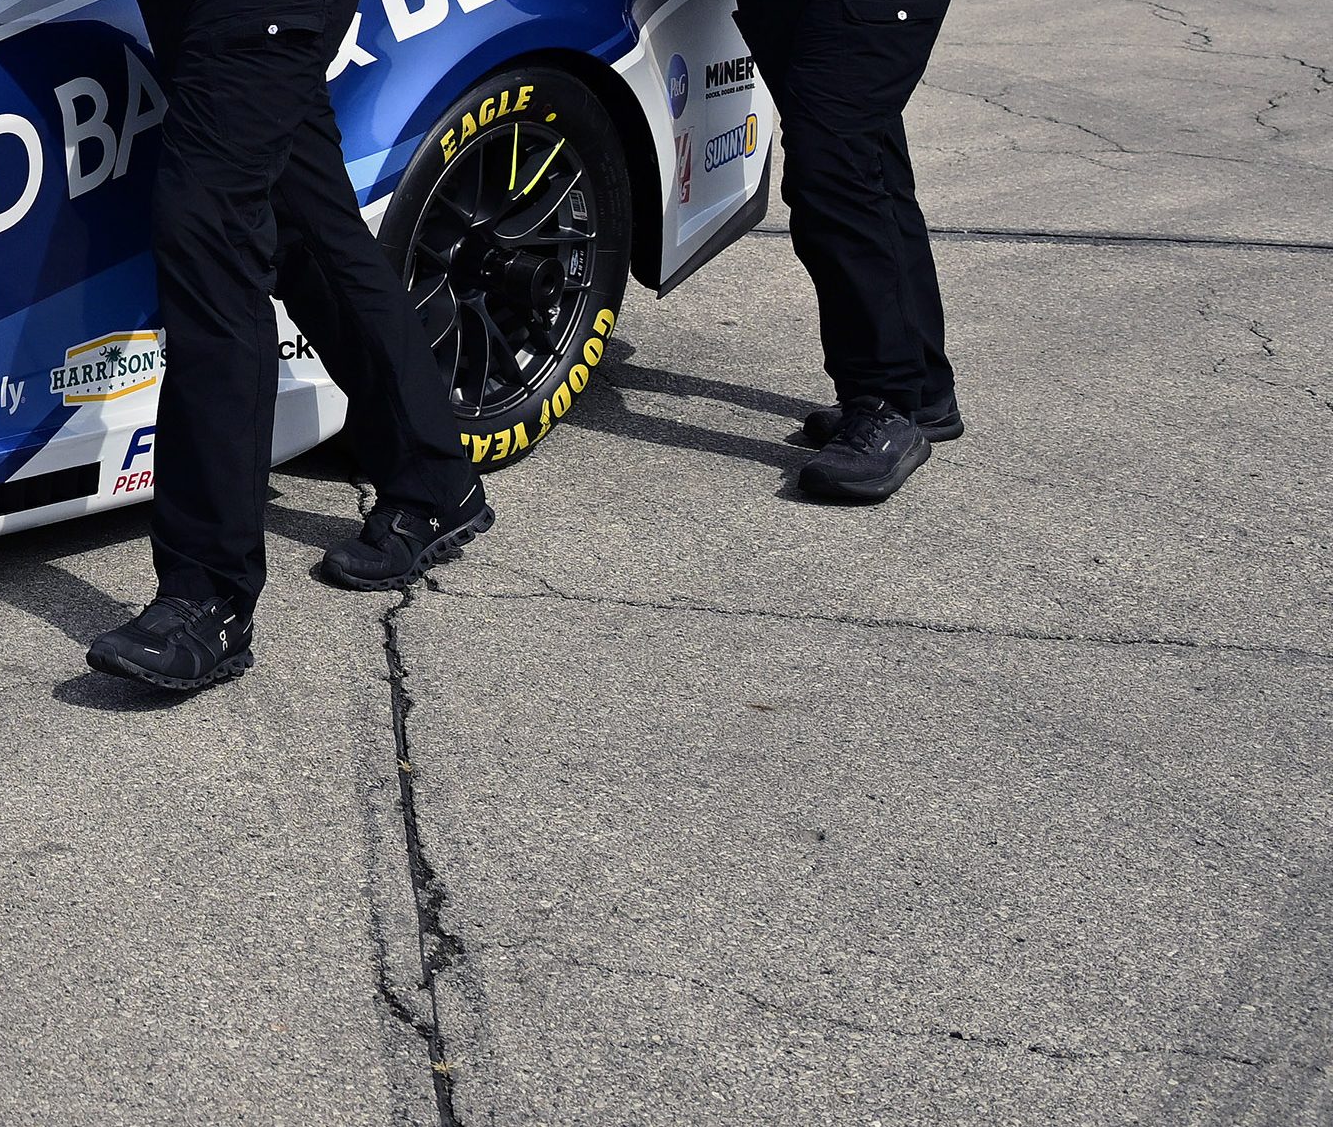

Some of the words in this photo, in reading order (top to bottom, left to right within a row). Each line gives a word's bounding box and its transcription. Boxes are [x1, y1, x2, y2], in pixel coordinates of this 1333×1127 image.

[670, 74, 686, 99] P&G
[705, 56, 755, 89] MINER
[439, 85, 535, 166] EAGLE
[113, 470, 155, 496] PER
